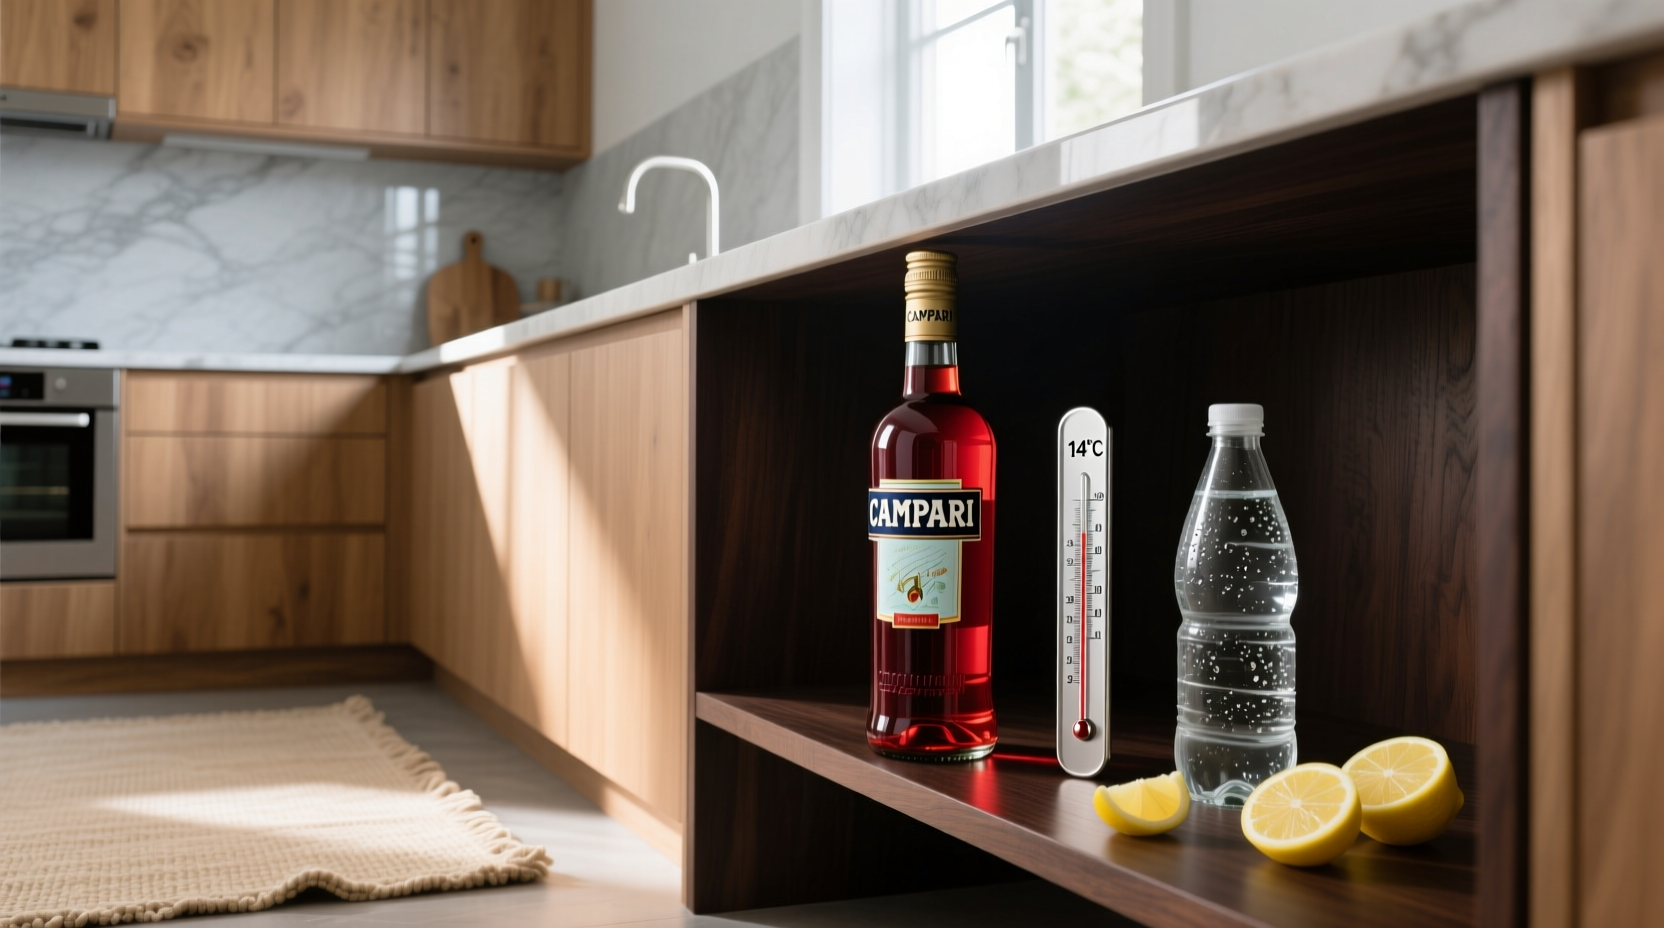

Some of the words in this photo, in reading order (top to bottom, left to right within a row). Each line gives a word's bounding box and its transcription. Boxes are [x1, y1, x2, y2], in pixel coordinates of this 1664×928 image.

[907, 309, 953, 323] CAMPARI
[1068, 439, 1104, 458] 14°C
[869, 498, 974, 528] CAMPARI
